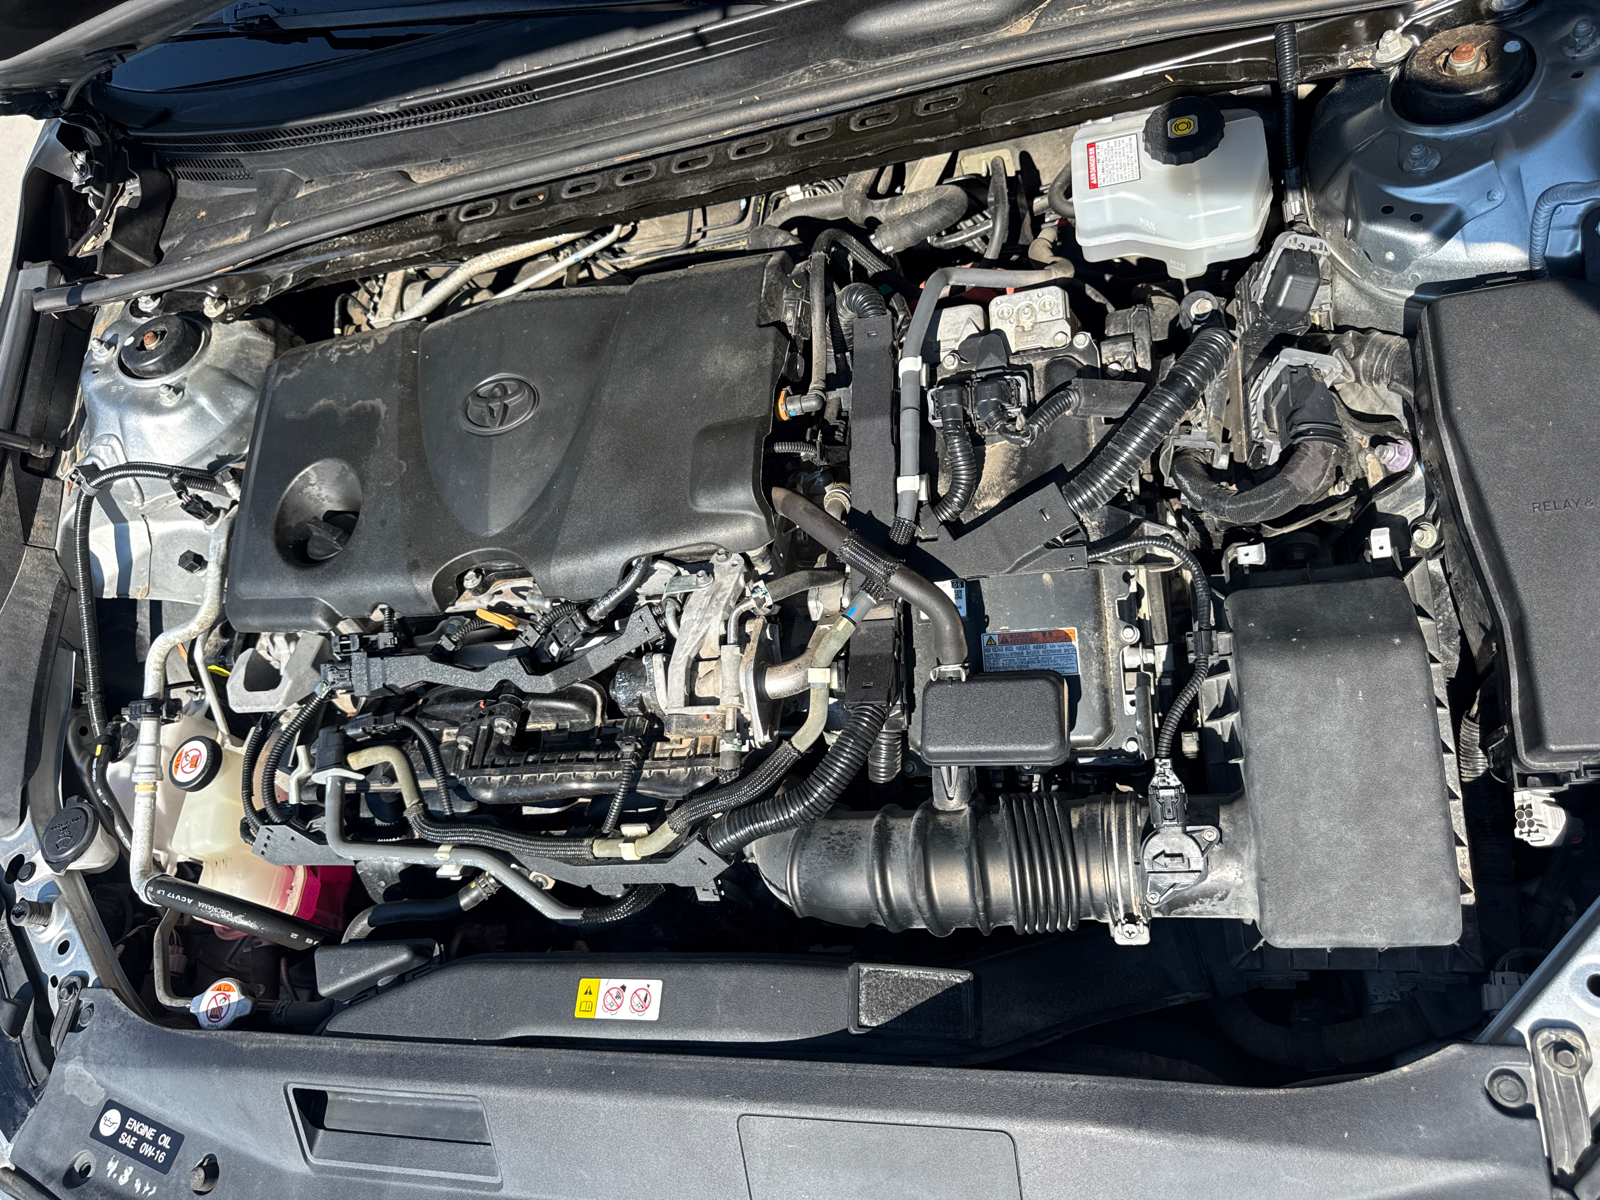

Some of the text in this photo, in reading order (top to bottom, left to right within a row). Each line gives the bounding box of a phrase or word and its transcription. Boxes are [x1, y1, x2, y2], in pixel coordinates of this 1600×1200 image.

[1531, 497, 1594, 512] RELAY &
[167, 892, 194, 905] ACV17
[197, 901, 233, 918] YOKOHAMA
[125, 1117, 172, 1149] ENGINE OIL
[118, 1131, 167, 1164] SAE 0W-16
[106, 1155, 134, 1186] 4.8
